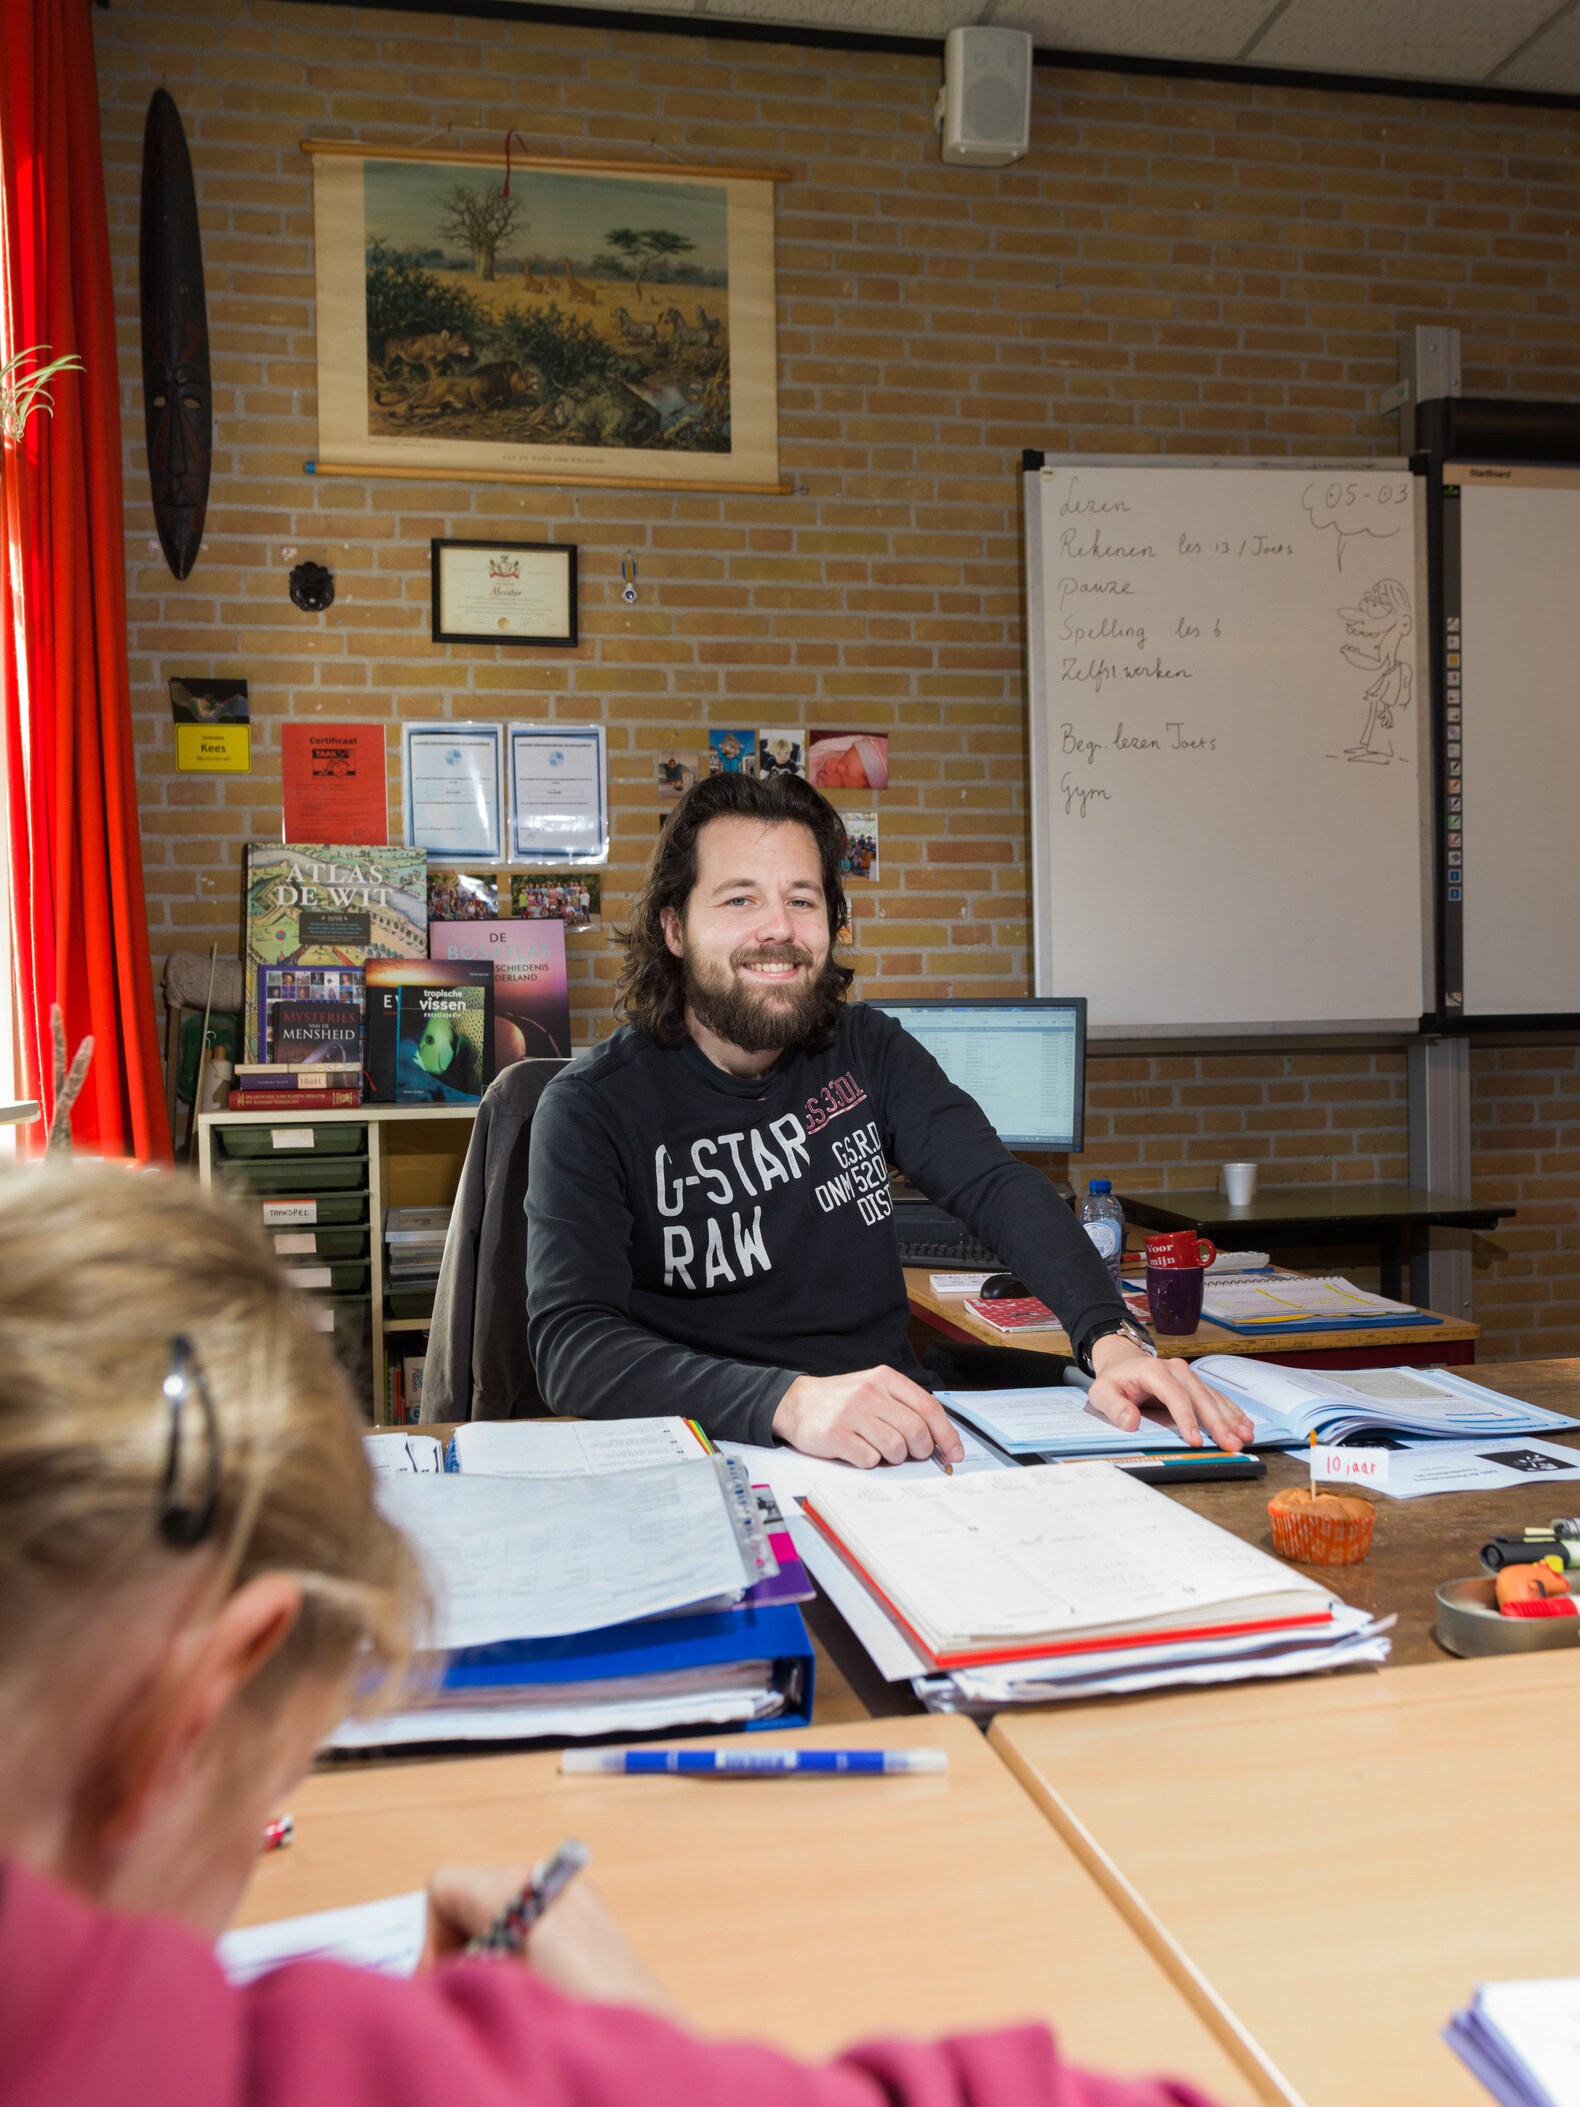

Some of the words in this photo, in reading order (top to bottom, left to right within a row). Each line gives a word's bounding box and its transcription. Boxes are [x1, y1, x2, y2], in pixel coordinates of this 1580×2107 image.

[1060, 476, 1131, 516] Lezen
[1060, 528, 1157, 558] Rekenen
[1179, 533, 1202, 555] les
[1215, 542, 1230, 554] 13
[1059, 615, 1147, 650] Spelling
[1175, 617, 1201, 638] les
[309, 737, 357, 745] Certificaat
[1113, 722, 1160, 750] lezen
[201, 743, 226, 753] Kees
[1061, 772, 1111, 819] Gym
[285, 863, 384, 884] ATLAS
[276, 886, 318, 906] DE
[327, 887, 394, 907] WIT
[489, 933, 507, 943] DE
[447, 943, 552, 960] BOSATLAS
[424, 989, 463, 998] tropische
[419, 997, 467, 1010] vissen
[283, 1012, 356, 1023] MYSTERIES
[283, 1029, 356, 1040] MENSHEID
[655, 1112, 811, 1217] G-STAR
[815, 1172, 856, 1213] DNM
[850, 1150, 888, 1193] 520
[269, 1208, 311, 1218] TAAKSPEL
[663, 1206, 772, 1290] RAW
[1147, 1244, 1174, 1253] Voor
[1149, 1256, 1176, 1267] mijn
[1327, 1455, 1341, 1474] 10
[1346, 1459, 1378, 1476] jaar
